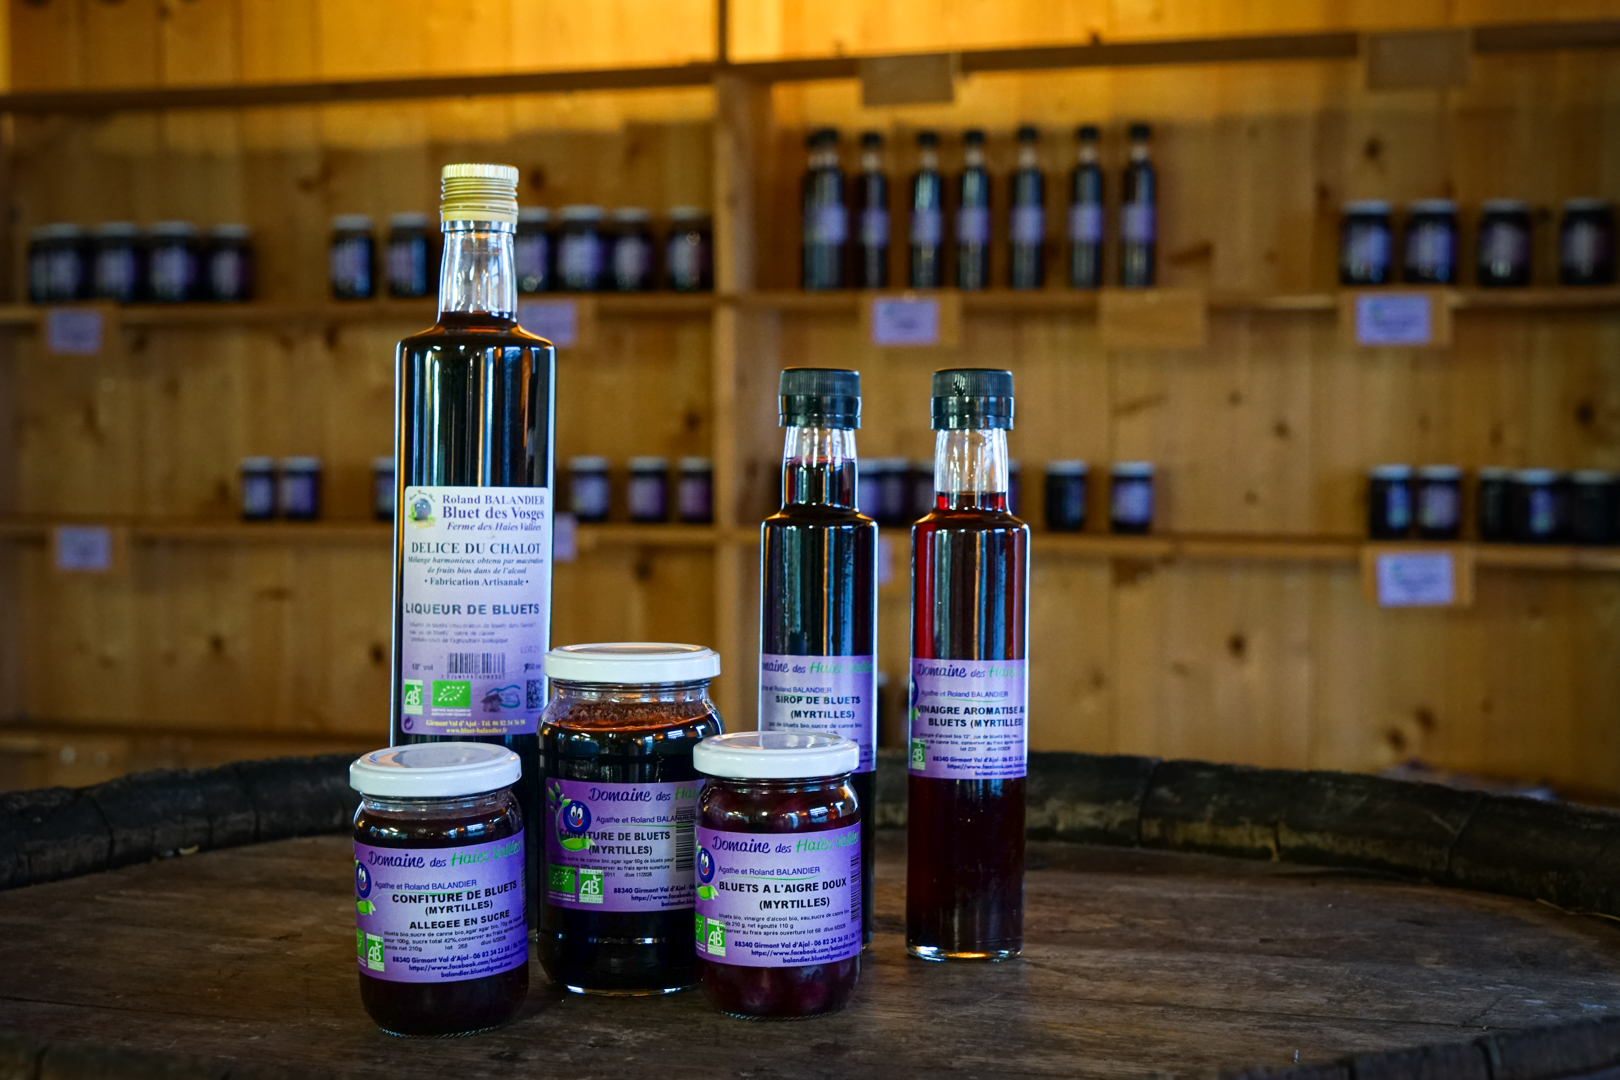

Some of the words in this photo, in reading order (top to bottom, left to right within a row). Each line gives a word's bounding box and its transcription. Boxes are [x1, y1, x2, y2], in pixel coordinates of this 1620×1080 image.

[443, 495, 480, 504] Roland
[485, 495, 544, 504] BALANDIER
[442, 506, 480, 518] Bluet
[485, 506, 507, 519] des
[511, 506, 544, 522] Vosges
[448, 522, 476, 530] Ferme
[478, 522, 492, 530] des
[495, 522, 518, 530] Haies
[412, 542, 460, 554] DELICE
[465, 543, 485, 554] DU
[490, 543, 541, 554] CHALOT
[436, 567, 455, 575] fruits
[430, 577, 480, 586] Fabrication
[482, 578, 524, 586] Artisanale
[406, 603, 462, 615] LIQUEUR
[467, 604, 487, 615] DE
[492, 603, 539, 615] BLUETS
[792, 664, 806, 674] des
[918, 663, 967, 678] Domaine
[970, 669, 985, 678] des
[775, 695, 802, 704] SIROP
[824, 696, 861, 704] BLUETS
[790, 710, 855, 719] (MYRTILLES)
[918, 705, 960, 715] VINAIGRE
[964, 706, 1017, 715] AROMATISE
[928, 718, 967, 727] BLUETS
[588, 788, 652, 802] Domaine
[656, 792, 671, 801] des
[596, 816, 619, 824] Agathe
[634, 832, 670, 840] BLUETS
[588, 846, 652, 856] (MYRTILLES)
[712, 836, 770, 854] Domaine
[775, 843, 792, 853] des
[796, 837, 833, 852] Haies
[368, 851, 425, 868] Domaine
[430, 857, 446, 867] des
[451, 849, 490, 866] Haies
[719, 866, 739, 874] Agathe
[776, 867, 820, 875] BALANDIER
[375, 881, 394, 889] Agathe
[432, 879, 477, 890] BALANDIER
[581, 880, 599, 894] AB
[719, 881, 758, 893] BLUETS
[763, 885, 771, 893] A
[774, 883, 818, 893] L'AIGRE
[822, 878, 846, 890] DOUX
[392, 892, 463, 903] CONFITURE
[467, 890, 481, 900] DE
[485, 880, 517, 897] BLUETS
[425, 900, 493, 916] (MYRTILLES)
[760, 897, 830, 911] (MYRTILLES)
[409, 920, 460, 929] ALLEGEE
[464, 918, 478, 927] EN
[481, 910, 510, 924] SUCRE
[708, 930, 722, 946] AB
[368, 946, 381, 961] AB
